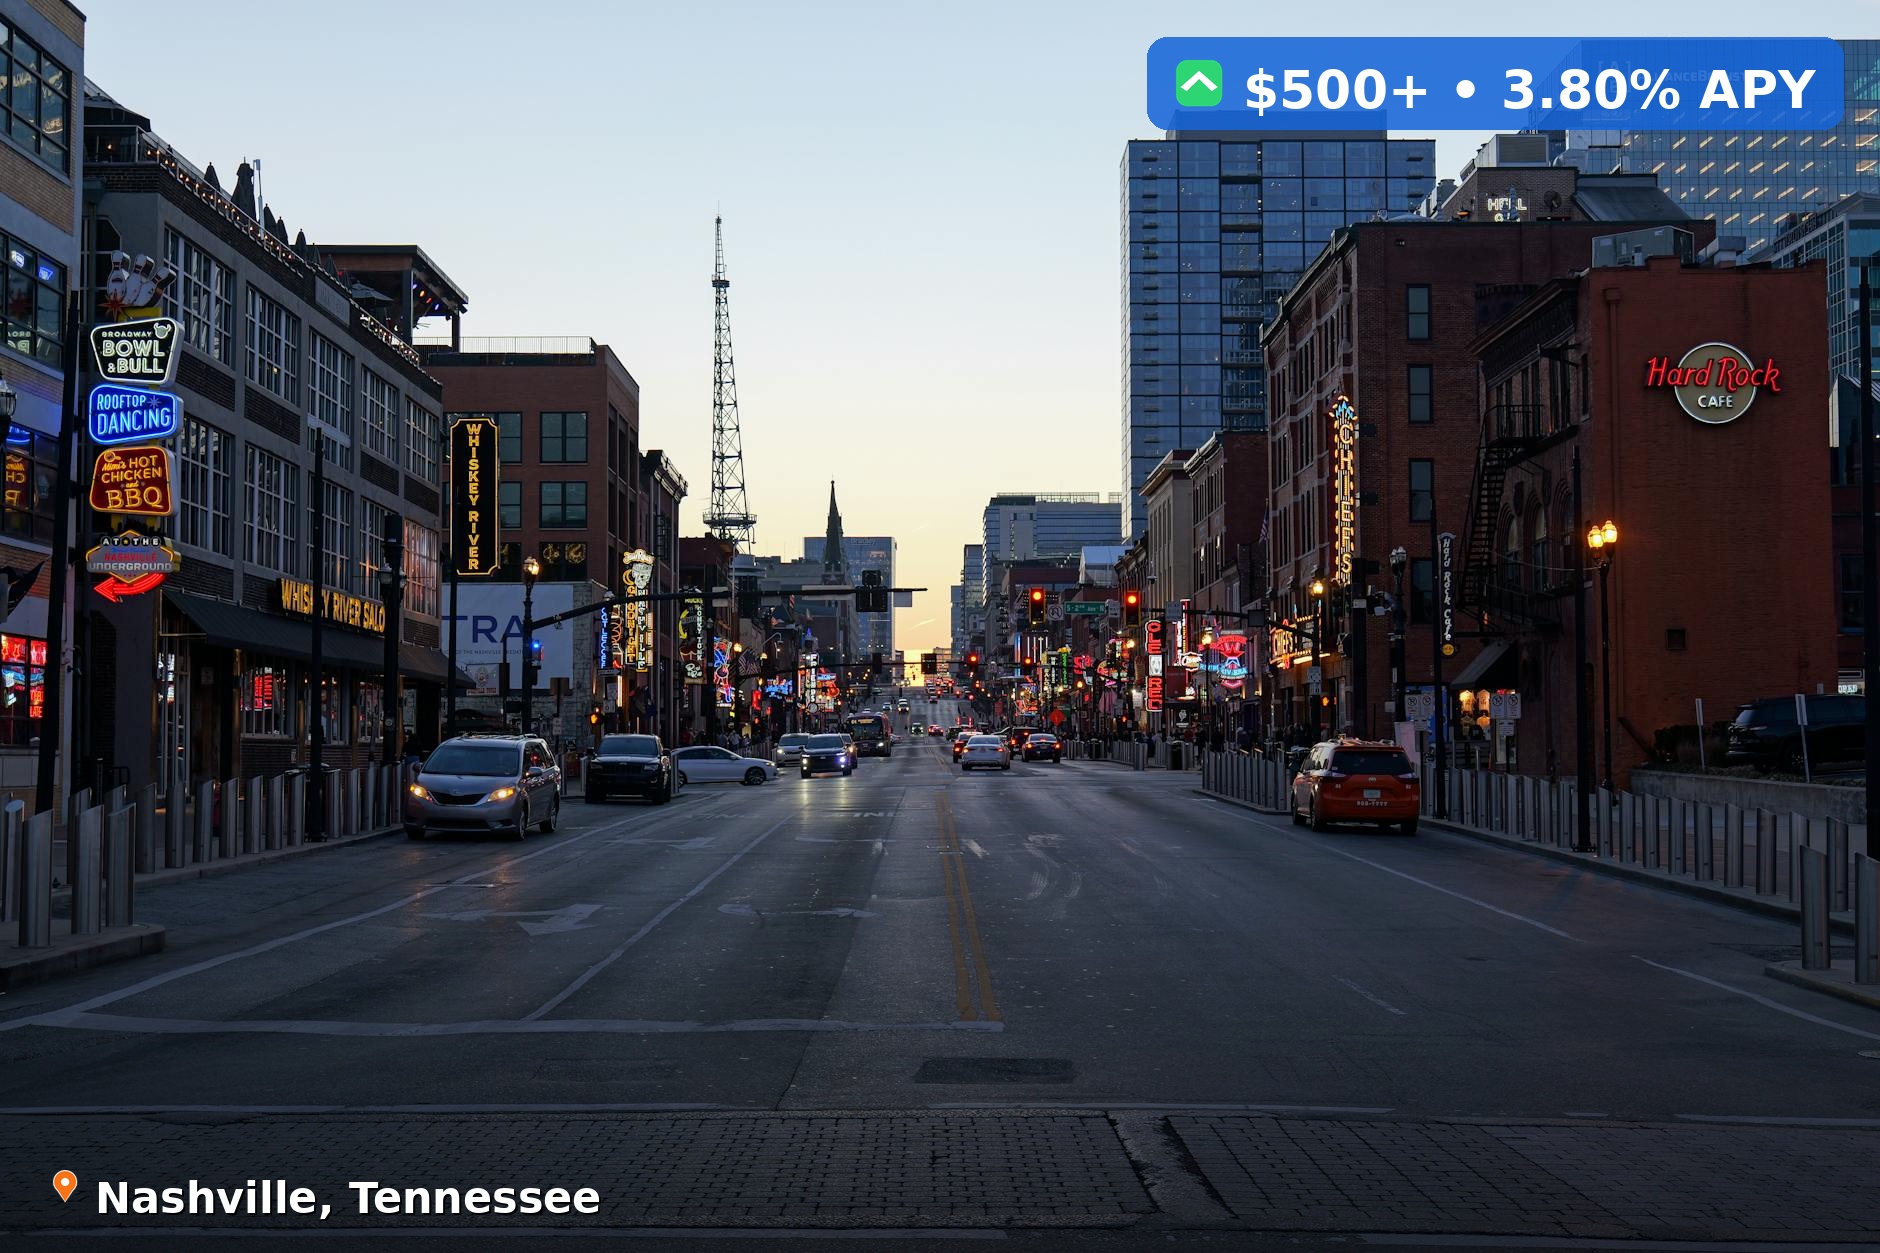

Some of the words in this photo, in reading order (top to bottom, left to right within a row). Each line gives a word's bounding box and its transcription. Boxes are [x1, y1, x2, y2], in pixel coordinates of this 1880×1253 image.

[102, 340, 165, 357] BOWL
[1647, 356, 1713, 387] Hard
[1716, 357, 1782, 392] Rock
[97, 394, 147, 411] ROOFTOP
[1697, 395, 1734, 408] CAFE
[97, 407, 172, 436] DANCING
[101, 466, 163, 484] CHICKEN
[102, 461, 127, 472] Mimi's
[129, 454, 159, 469] HOT
[466, 423, 482, 506] WHISKEY
[105, 486, 164, 509] BBQ
[125, 480, 139, 489] and
[1339, 423, 1353, 574] CHIEFS
[102, 537, 119, 546] AT
[133, 537, 160, 546] THE
[468, 511, 480, 570] RIVER
[1442, 538, 1451, 568] Hard
[88, 561, 173, 572] UNDERGROUND
[104, 551, 157, 562] NASHVILLE
[1443, 571, 1452, 605] Rock
[281, 578, 330, 619] WHISY
[333, 592, 361, 628] RIVER
[363, 602, 386, 633] SALO
[1147, 621, 1162, 654] OLE
[1443, 609, 1452, 641] Cafe
[1147, 677, 1163, 710] RED
